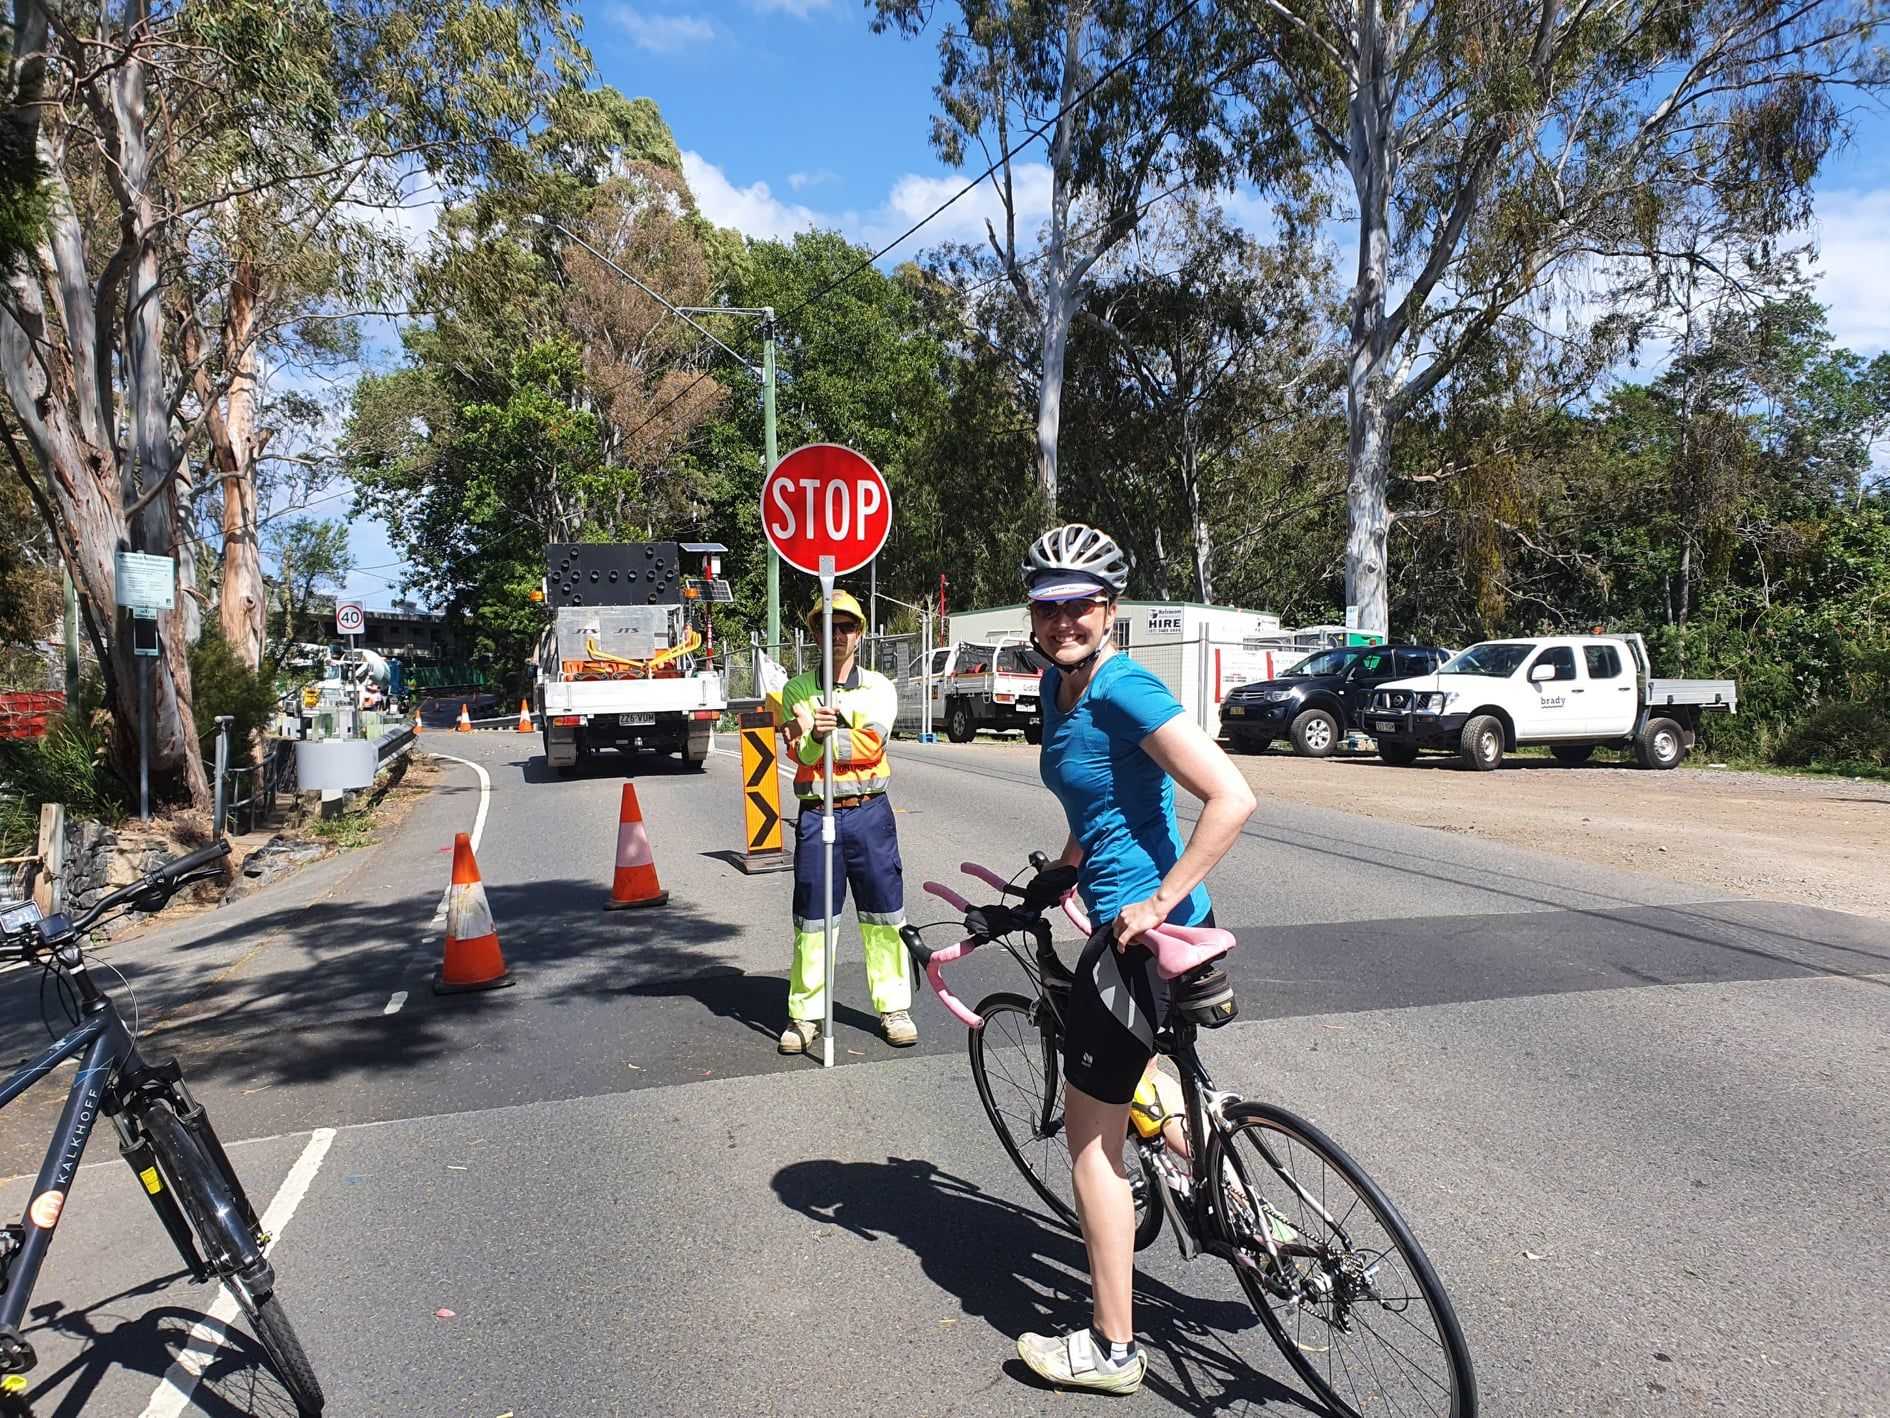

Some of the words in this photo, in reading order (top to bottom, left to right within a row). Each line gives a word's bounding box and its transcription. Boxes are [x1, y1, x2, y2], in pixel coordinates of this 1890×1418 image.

[772, 477, 881, 541] STOP
[341, 611, 360, 623] 40
[1149, 619, 1181, 628] HIRE
[1540, 696, 1566, 707] brady
[56, 1088, 99, 1184] KALKHOFF
